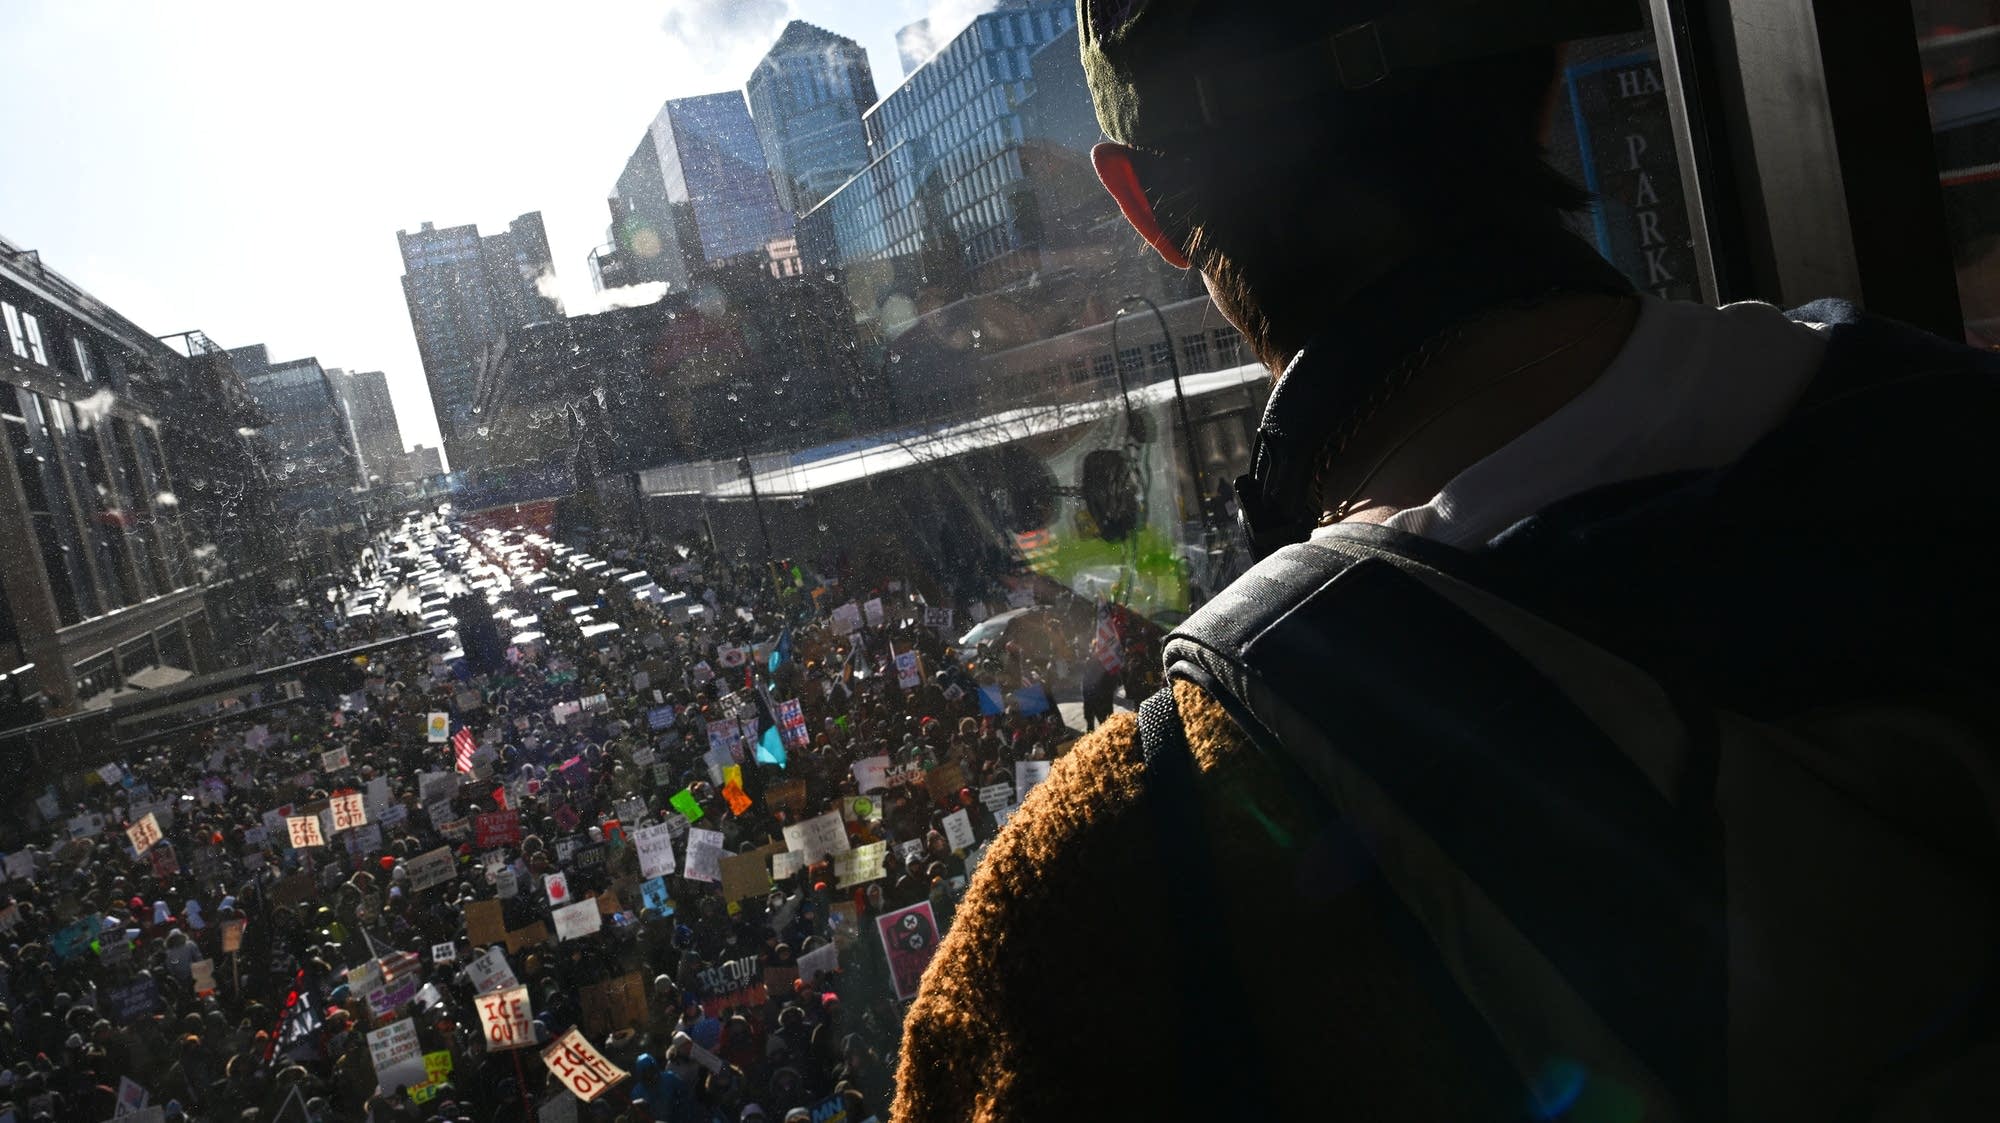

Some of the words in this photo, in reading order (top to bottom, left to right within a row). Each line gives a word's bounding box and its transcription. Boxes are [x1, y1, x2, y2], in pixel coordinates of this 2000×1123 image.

[334, 800, 359, 815] ICE
[291, 823, 315, 834] ICE
[337, 813, 362, 827] OUT!
[294, 834, 319, 846] OUT!
[476, 956, 495, 972] ICE
[697, 965, 728, 987] ICE
[730, 955, 758, 981] OUT
[485, 999, 523, 1021] ICE
[491, 1020, 529, 1043] OUT!
[553, 1043, 595, 1077] ICE
[573, 1061, 616, 1094] OUT!
